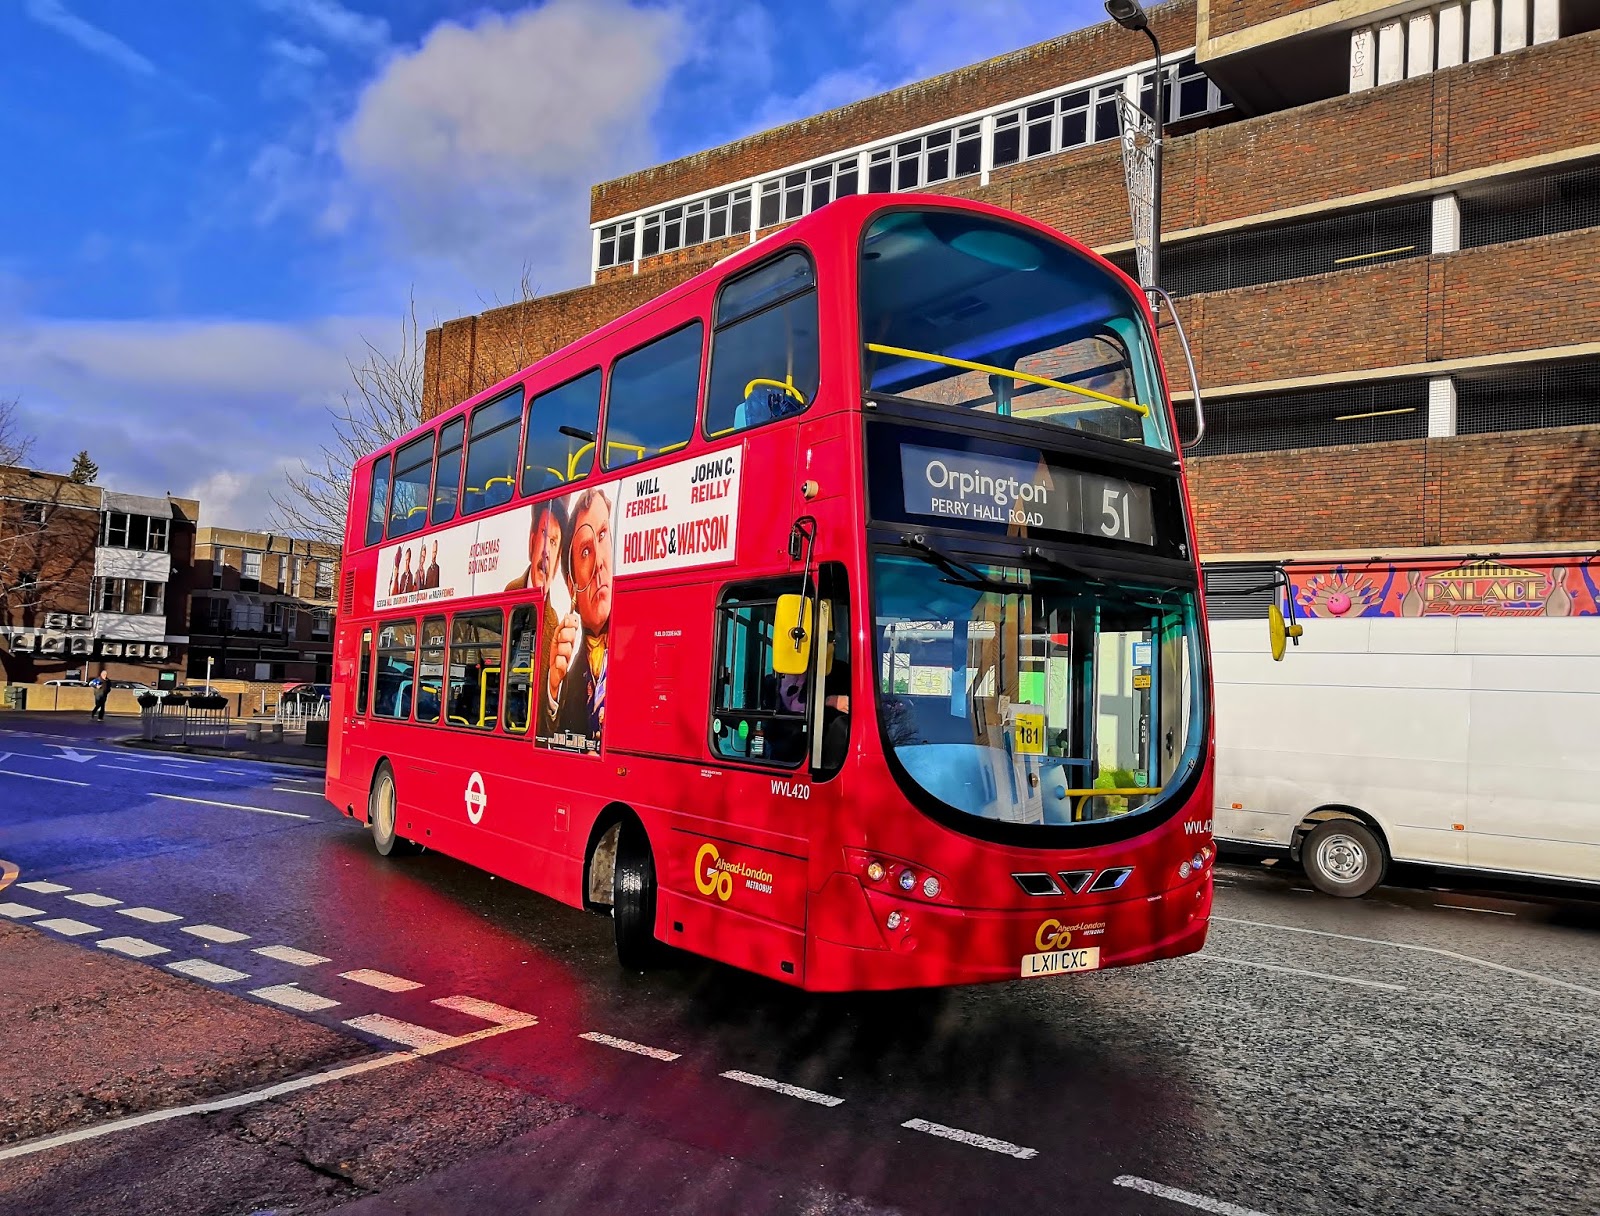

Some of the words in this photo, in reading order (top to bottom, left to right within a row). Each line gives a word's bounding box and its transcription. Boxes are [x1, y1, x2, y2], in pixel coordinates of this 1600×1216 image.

[691, 460, 723, 484] JOHN
[725, 456, 735, 476] C.
[925, 460, 1048, 506] Orpington
[636, 477, 660, 497] WILL
[691, 478, 732, 504] REILLY
[626, 494, 668, 518] FERRELL
[931, 498, 969, 515] PERRY
[973, 503, 1005, 522] HALL
[1009, 509, 1044, 526] ROAD
[1100, 489, 1130, 539] 51
[623, 526, 668, 564] HOLMES
[668, 527, 676, 554] &
[677, 514, 729, 556] WATSON
[1425, 581, 1546, 601] PALACE
[1020, 727, 1038, 744] 181
[771, 779, 810, 800] WVL420
[694, 842, 733, 901] Go
[715, 857, 773, 883] Ahead-London
[745, 879, 773, 895] METROBUS
[1035, 918, 1072, 951] Go
[1057, 921, 1106, 933] Ahead-London
[1031, 953, 1058, 973] LX11
[1062, 950, 1088, 969] CXC
